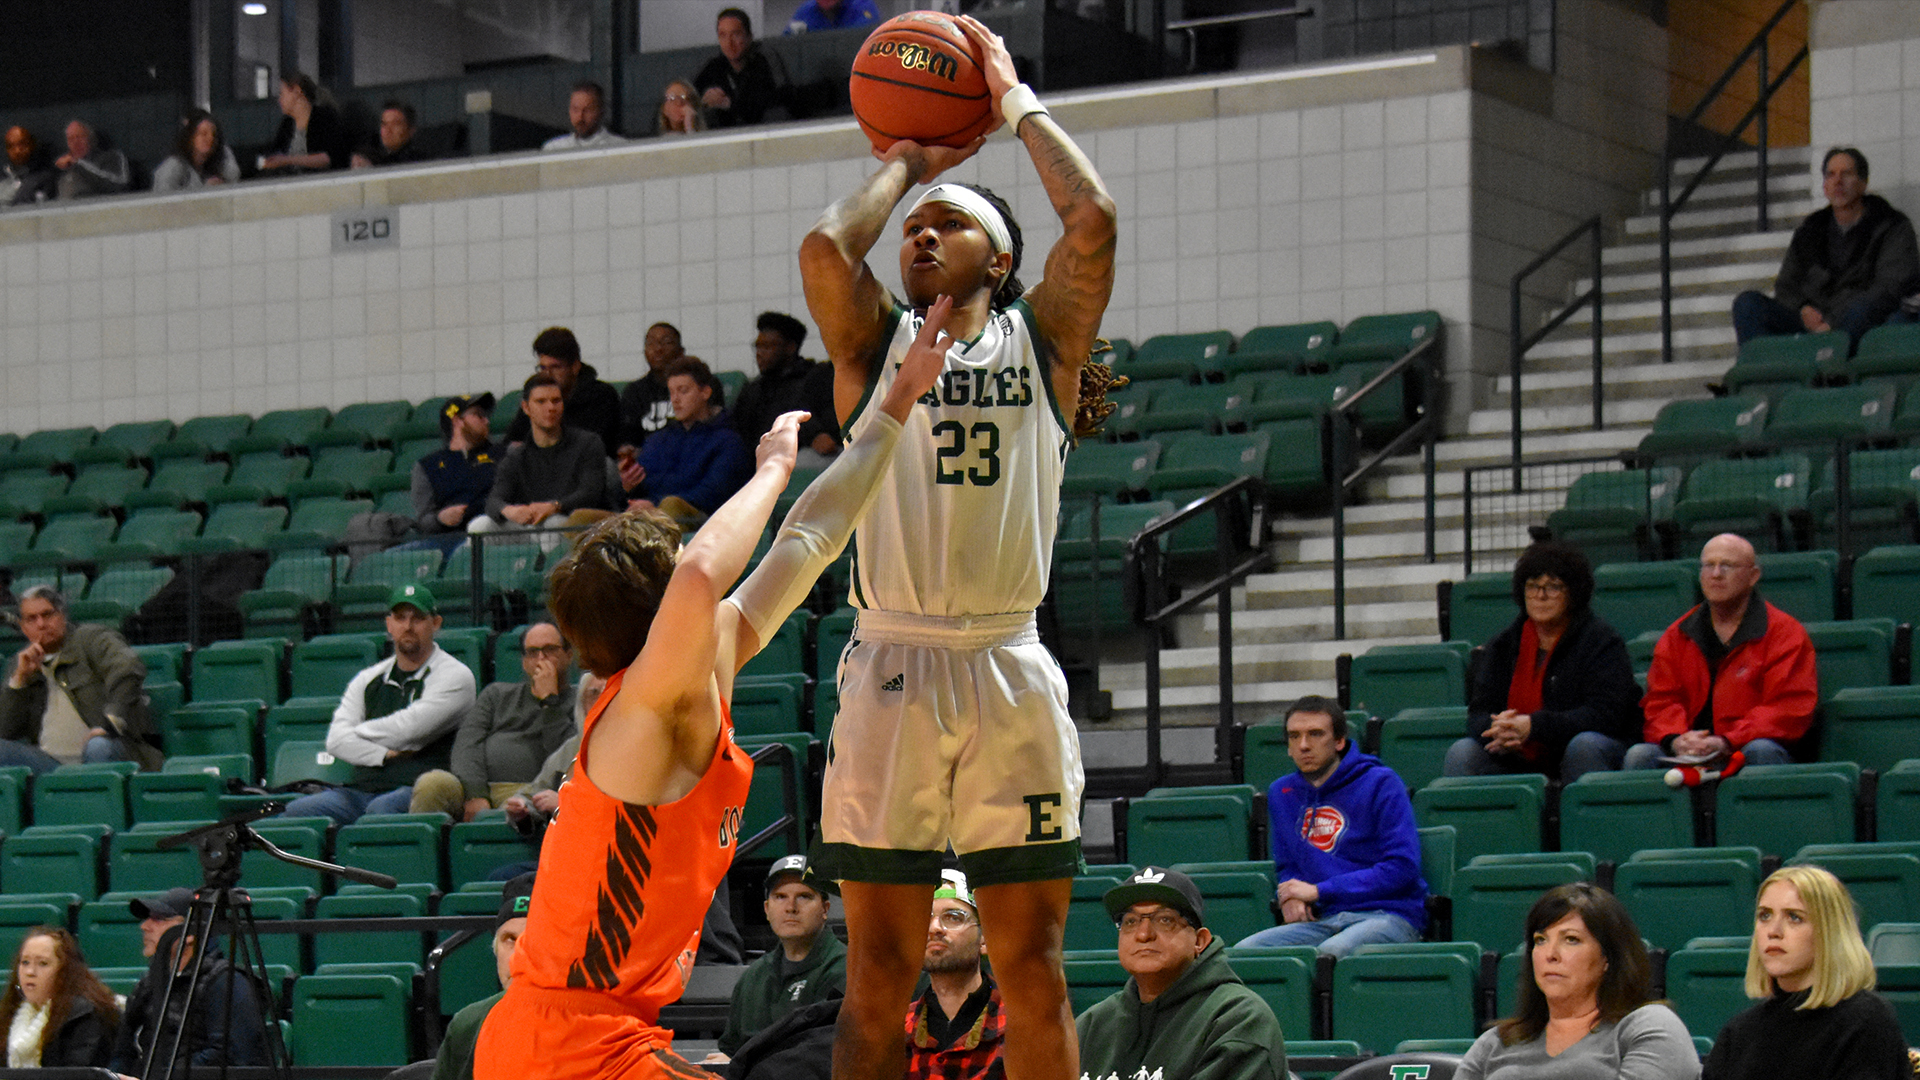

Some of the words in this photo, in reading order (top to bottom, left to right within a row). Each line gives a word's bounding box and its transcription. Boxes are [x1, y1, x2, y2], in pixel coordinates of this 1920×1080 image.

[868, 41, 958, 82] Wilson
[342, 218, 391, 241] 120
[895, 363, 1033, 408] AGLES
[932, 420, 1000, 486] 23
[1023, 793, 1062, 842] E
[785, 857, 803, 869] E
[513, 896, 530, 912] E
